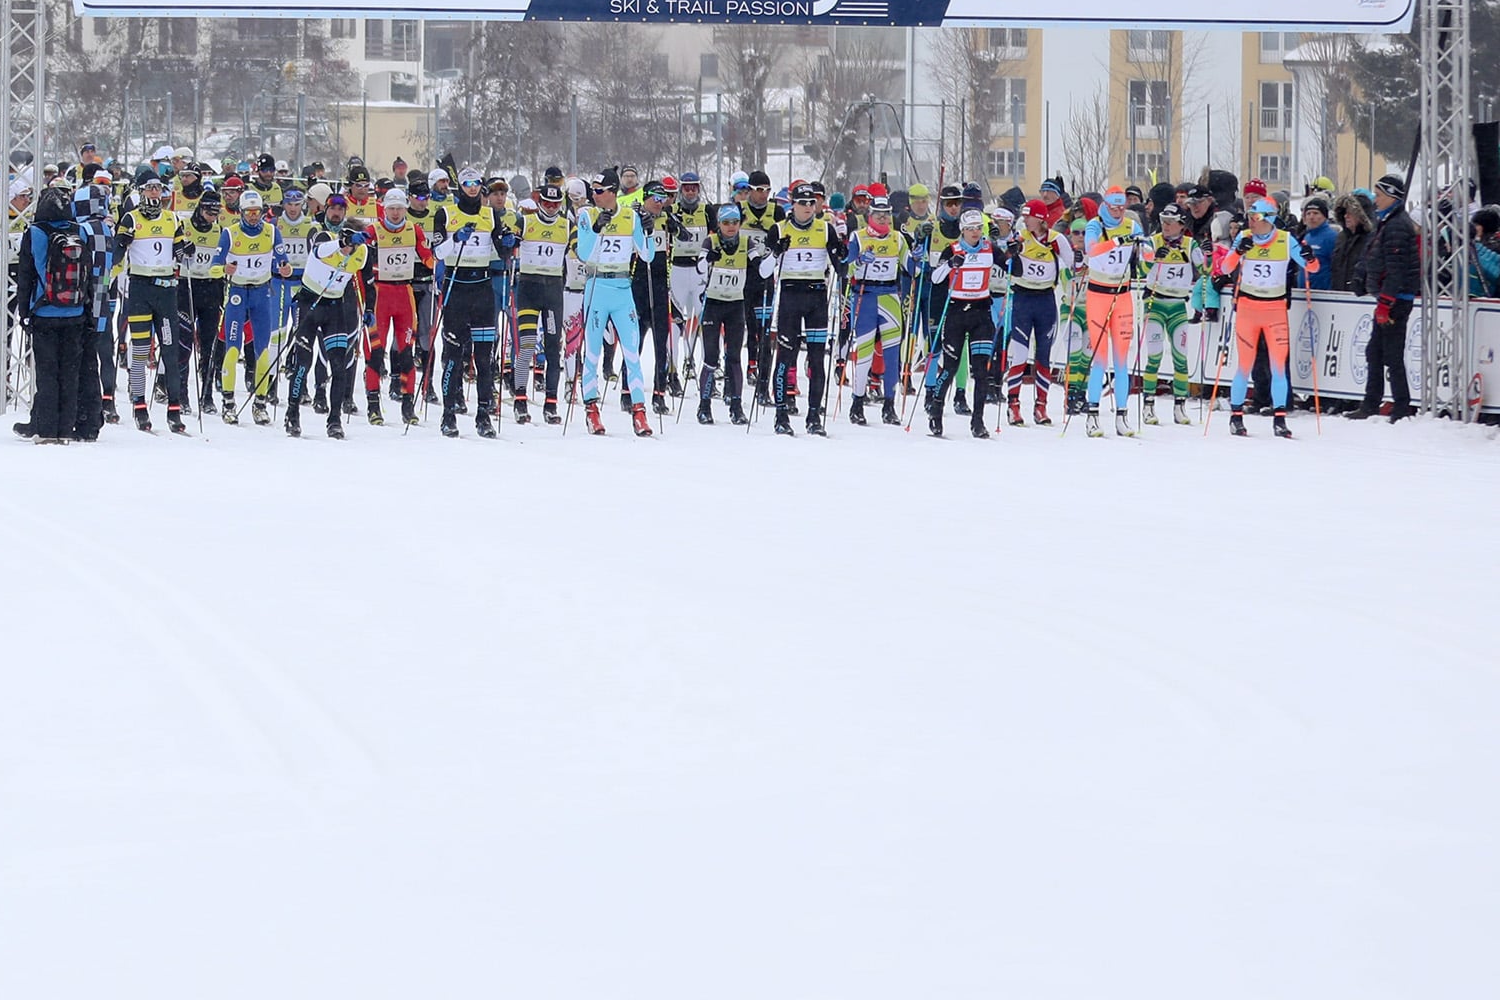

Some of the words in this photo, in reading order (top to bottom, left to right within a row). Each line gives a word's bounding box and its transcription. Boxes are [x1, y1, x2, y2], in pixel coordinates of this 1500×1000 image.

[609, 0, 641, 14] SKI
[646, 0, 660, 14] &
[665, 0, 721, 15] TRAIL
[726, 1, 810, 16] PASSION
[471, 235, 480, 247] 3
[603, 239, 621, 253] 25
[655, 236, 662, 247] 9
[153, 241, 162, 256] 9
[285, 244, 304, 255] 212
[537, 246, 554, 257] 10
[196, 253, 210, 264] 89
[387, 254, 408, 265] 652
[796, 252, 813, 262] 12
[1108, 250, 1124, 264] 51
[246, 258, 262, 269] 16
[872, 261, 890, 273] 55
[1027, 263, 1045, 276] 58
[1167, 267, 1184, 280] 54
[1253, 264, 1272, 277] 53
[719, 275, 739, 287] 170
